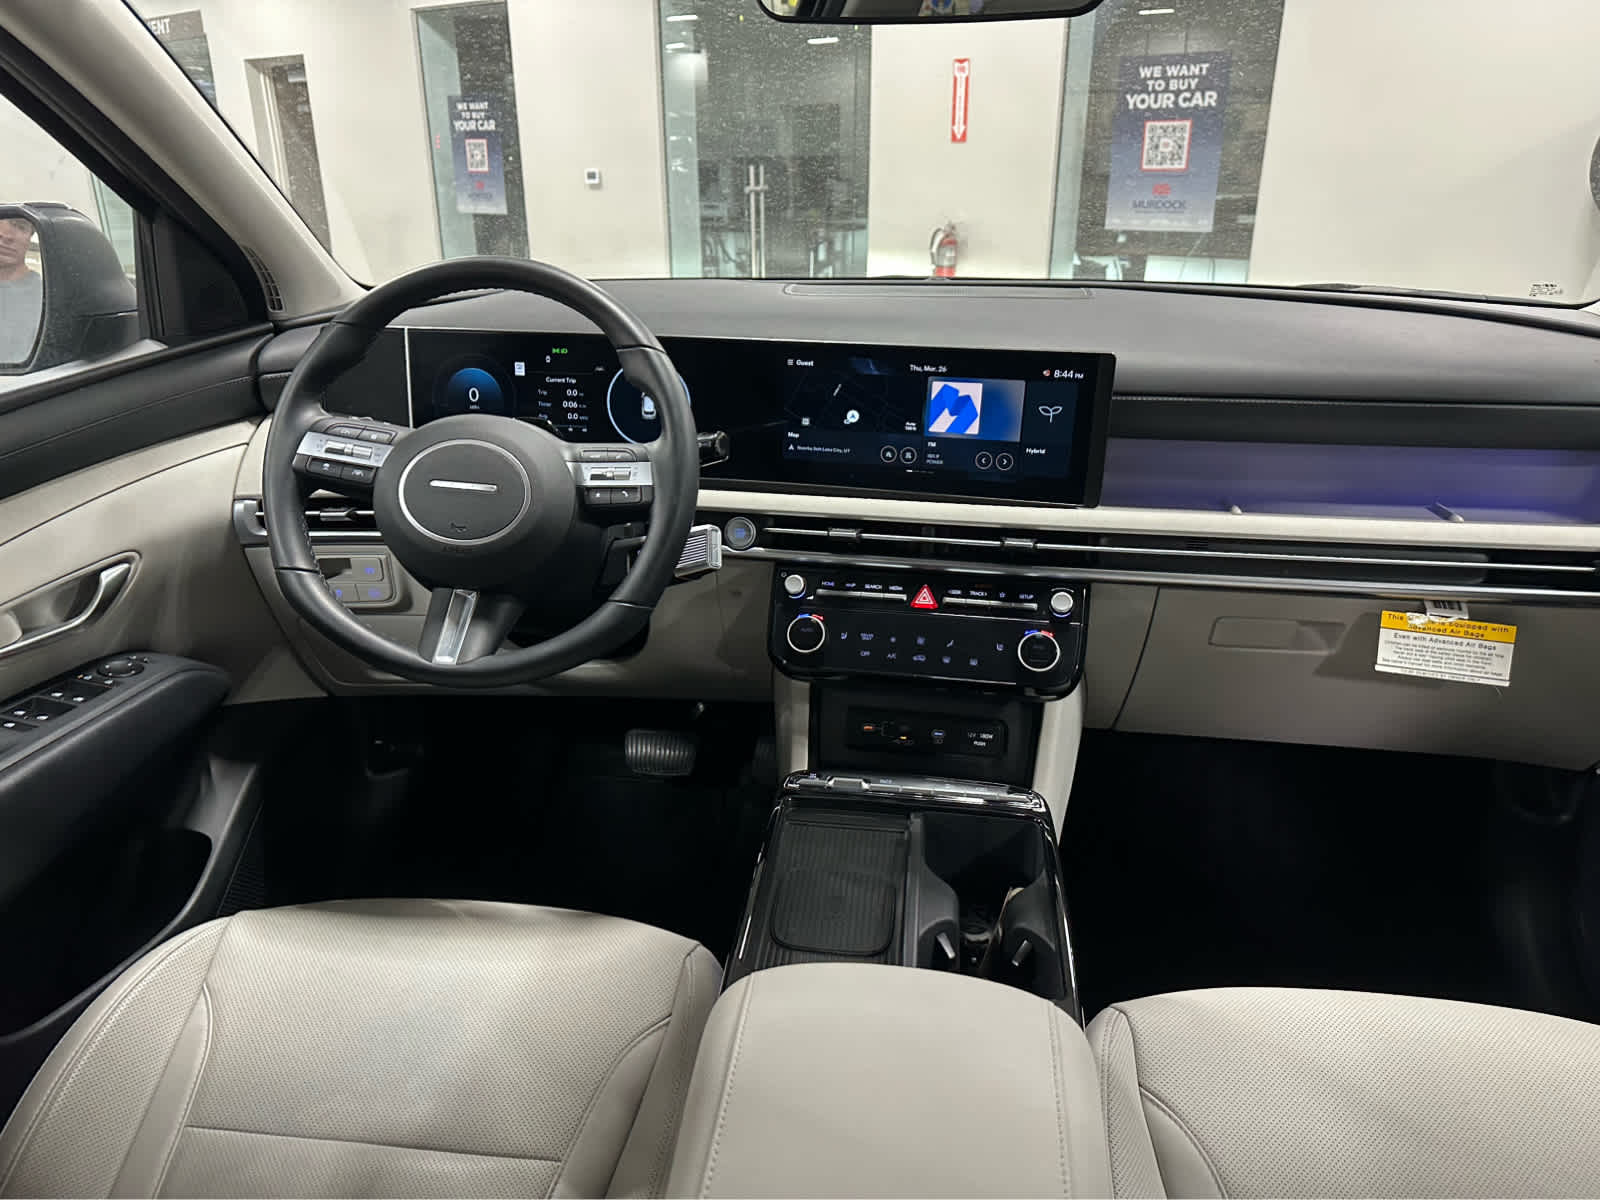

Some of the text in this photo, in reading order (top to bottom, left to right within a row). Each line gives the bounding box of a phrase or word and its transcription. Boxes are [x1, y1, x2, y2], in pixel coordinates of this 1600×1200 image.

[1139, 63, 1210, 79] WE WANT
[1146, 78, 1199, 91] TO BUY
[1126, 91, 1218, 109] YOUR CAR
[453, 119, 496, 131] YOUR CAR
[796, 359, 814, 367] Guest
[1053, 369, 1074, 379] 8:44
[468, 387, 479, 401] 0
[1388, 613, 1404, 621] This
[1464, 629, 1485, 639] Bags
[1393, 632, 1410, 640] Even
[1429, 636, 1465, 646] Advanced
[1478, 642, 1497, 651] Bags
